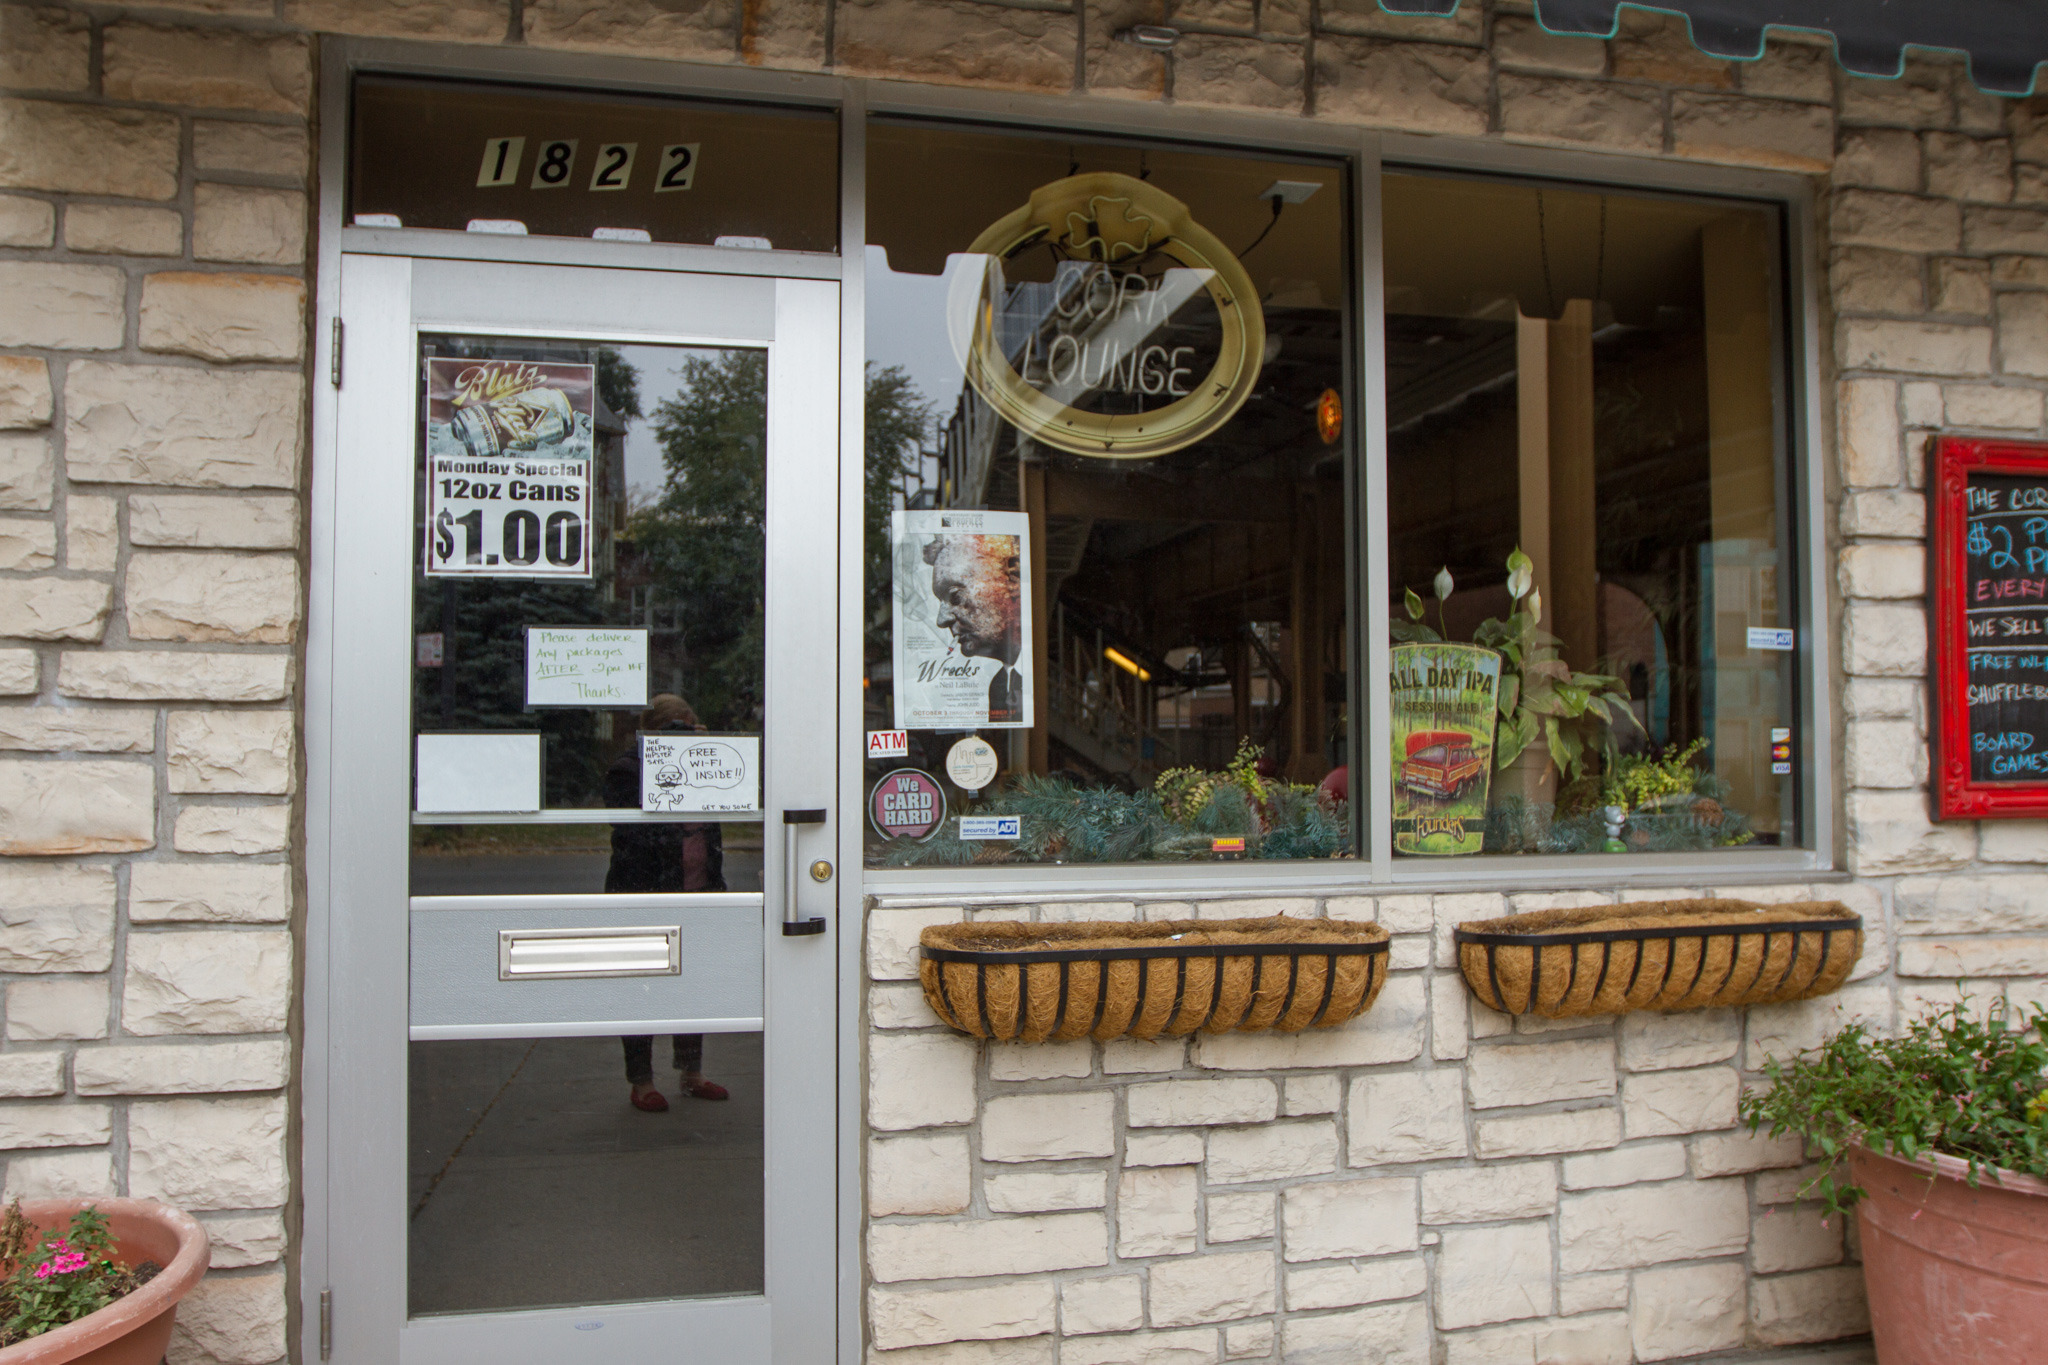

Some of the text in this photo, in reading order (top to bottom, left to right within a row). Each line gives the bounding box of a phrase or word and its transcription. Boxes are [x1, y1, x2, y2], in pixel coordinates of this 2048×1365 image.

[493, 139, 692, 188] 1822
[1055, 266, 1178, 327] CORK
[1021, 334, 1195, 396] LOUNGE
[451, 361, 548, 406] Blatz
[437, 460, 583, 477] Monday Special
[439, 478, 581, 502] 12oz Cans
[1965, 486, 2001, 512] THE
[436, 507, 582, 567] $1.00
[1967, 521, 2020, 569] $2
[1975, 579, 2047, 601] EVERY
[1968, 618, 1997, 637] WE
[1999, 616, 2043, 637] SELL
[566, 648, 623, 660] packages
[1969, 653, 2016, 671] FREE
[917, 656, 981, 683] Wrecks
[1389, 667, 1493, 694] ALL DAY IPA
[1404, 701, 1479, 713] SESSION ALE
[646, 744, 675, 752] HELPFUL
[870, 732, 906, 750] ATM
[1973, 732, 2034, 752] BOARD
[645, 751, 672, 759] HIPSTER
[689, 748, 717, 758] FREE
[689, 759, 722, 768] WI-FI
[896, 777, 920, 792] We
[883, 792, 933, 811] CARD
[884, 810, 933, 826] HARD
[988, 827, 997, 835] by
[999, 822, 1017, 833] ADT
